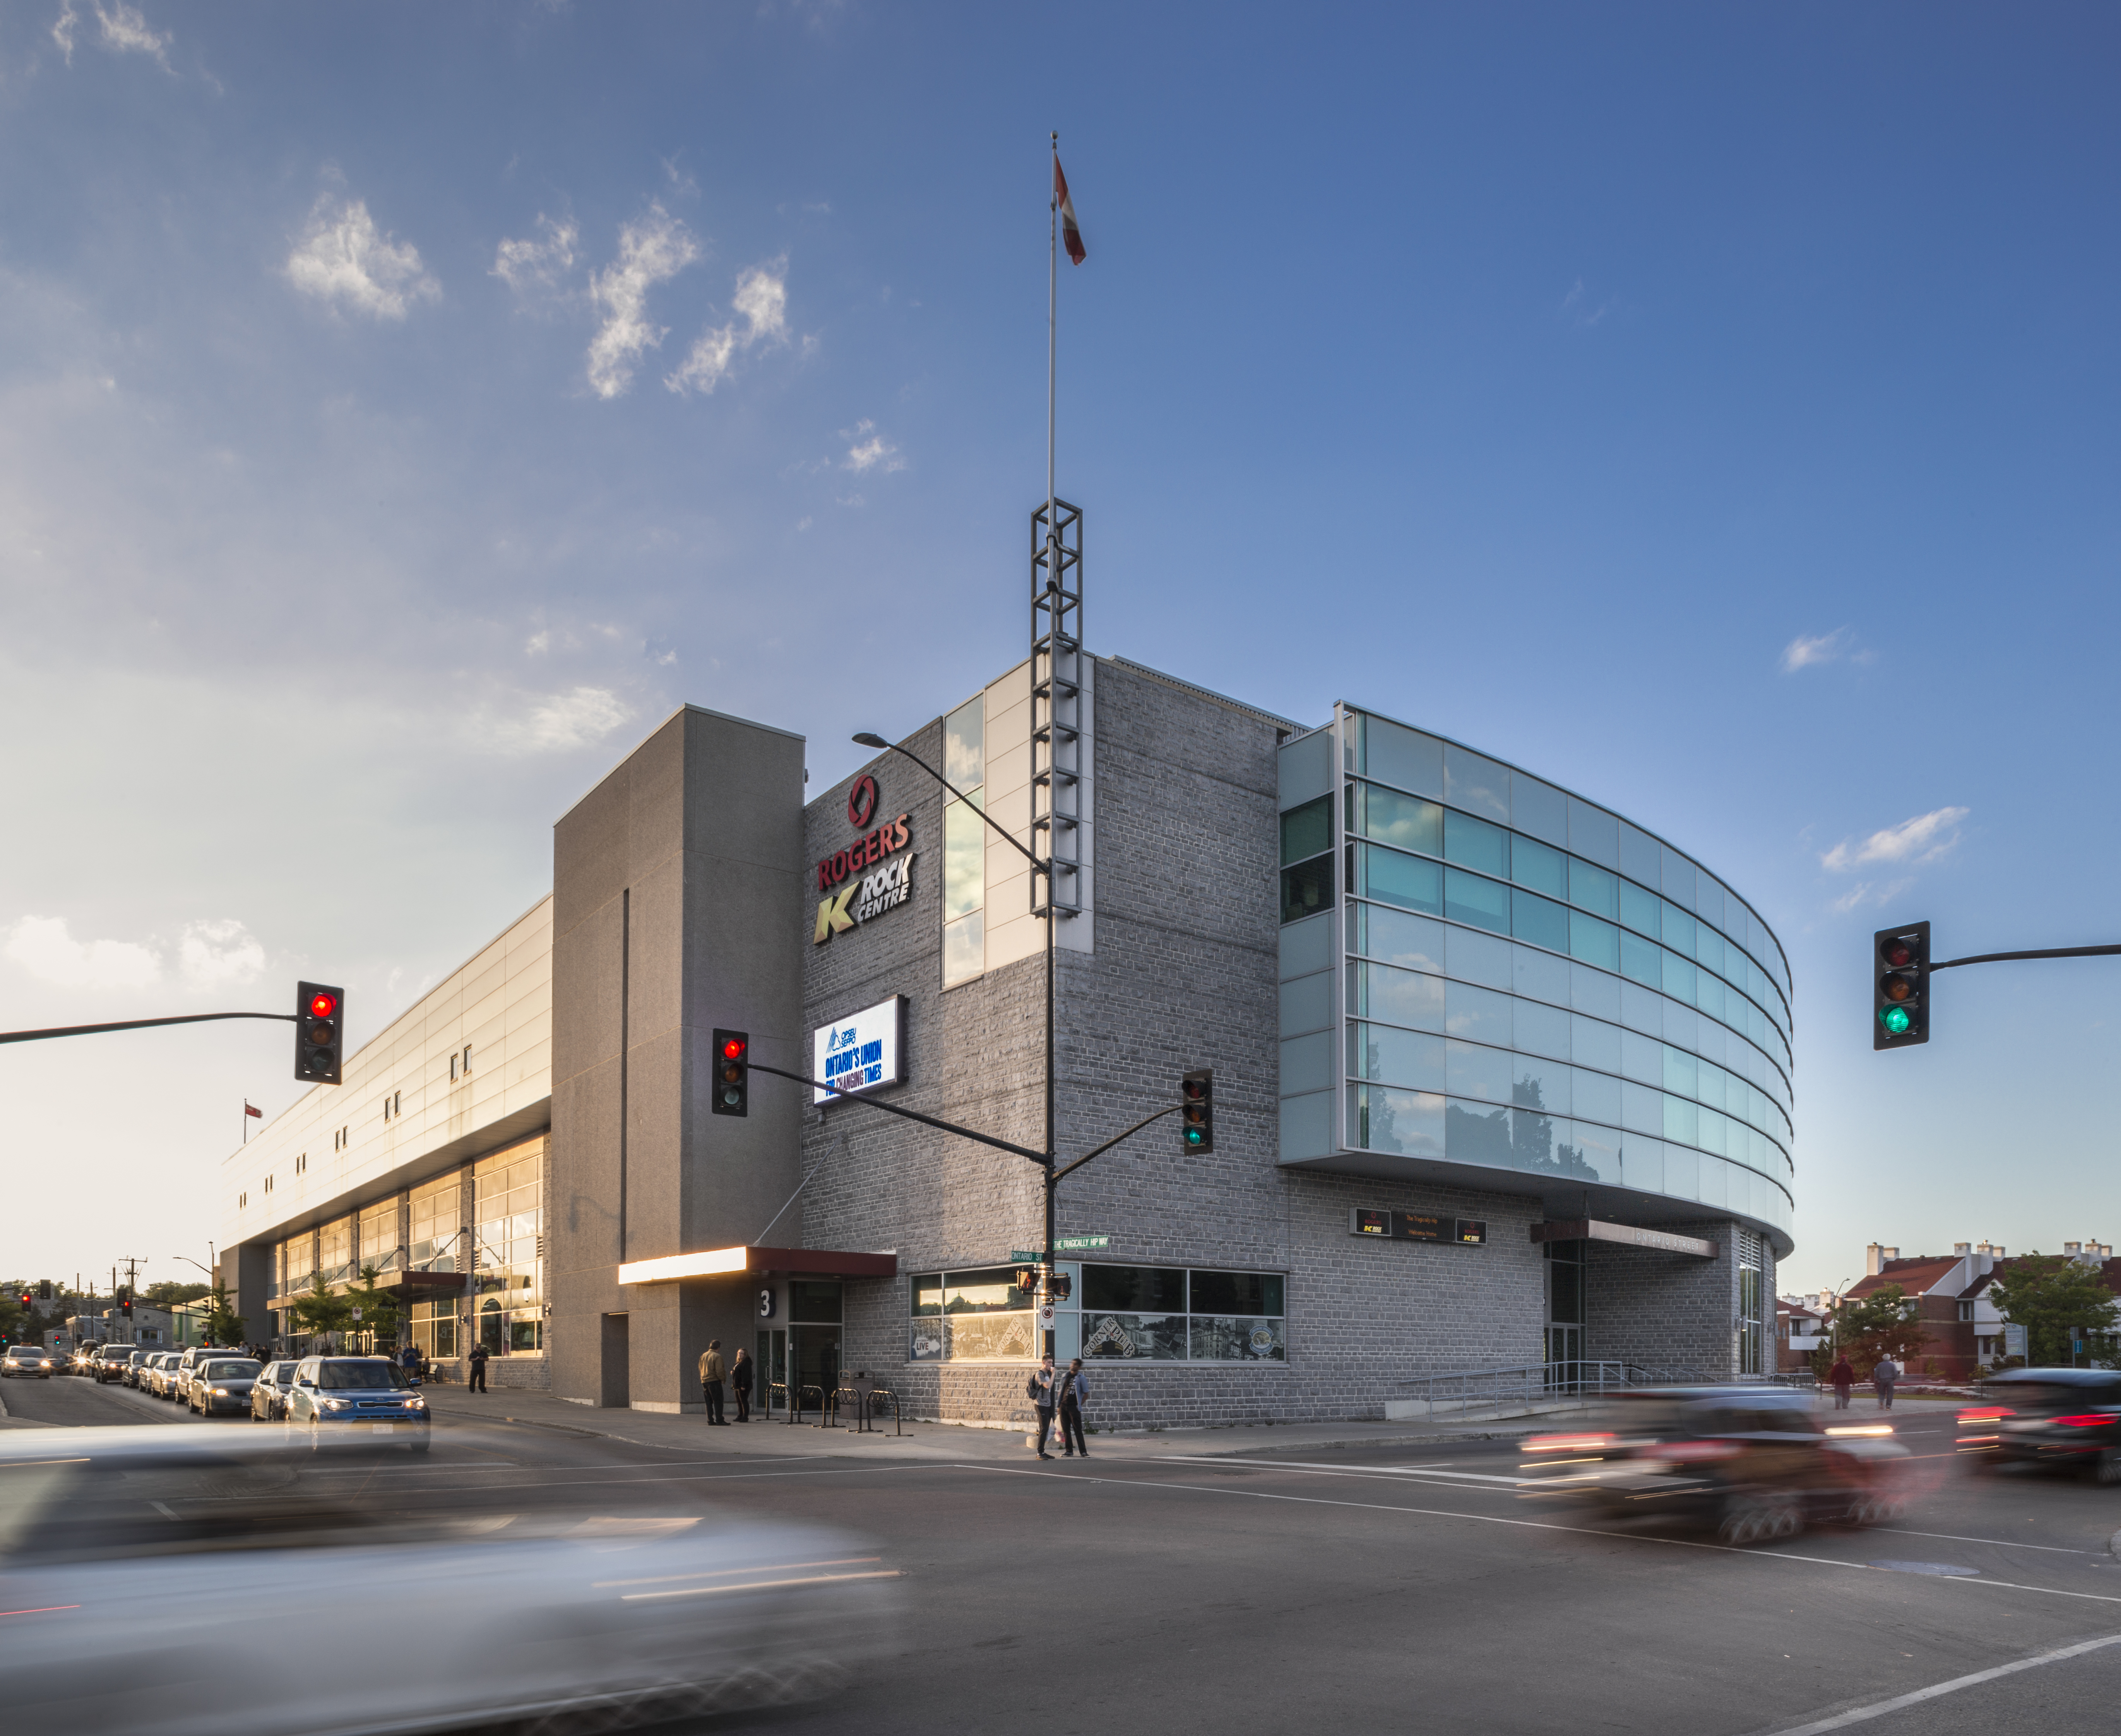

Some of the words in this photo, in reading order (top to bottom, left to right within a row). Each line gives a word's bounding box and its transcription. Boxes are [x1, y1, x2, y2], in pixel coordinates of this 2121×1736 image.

[818, 814, 909, 890] ROGERS
[813, 881, 860, 944] K
[861, 853, 914, 905] ROCK
[858, 883, 909, 922] CENTRE
[841, 1027, 856, 1040] OPSEU
[841, 1036, 856, 1048] SEFPO
[825, 1047, 859, 1078] ONTARIO'S
[861, 1039, 882, 1066] UNION
[826, 1079, 835, 1097] FOR
[836, 1069, 864, 1091] CHANGING
[864, 1063, 882, 1084] TIMES
[1054, 1240, 1062, 1249] THE
[1063, 1238, 1089, 1248] TRAGICALLY
[1099, 1237, 1108, 1245] WAY
[1637, 1232, 1669, 1246] ONTARIO
[1674, 1239, 1699, 1250] STREET
[1012, 1252, 1032, 1261] ONTARIO
[1036, 1253, 1043, 1261] ST
[761, 1290, 770, 1316] 3
[997, 1319, 1019, 1355] CORNER
[1016, 1326, 1032, 1355] PUB
[1084, 1318, 1114, 1356] CORNER
[1111, 1326, 1133, 1356] PUB
[1554, 1335, 1561, 1352] 2
[1569, 1336, 1575, 1353] 2
